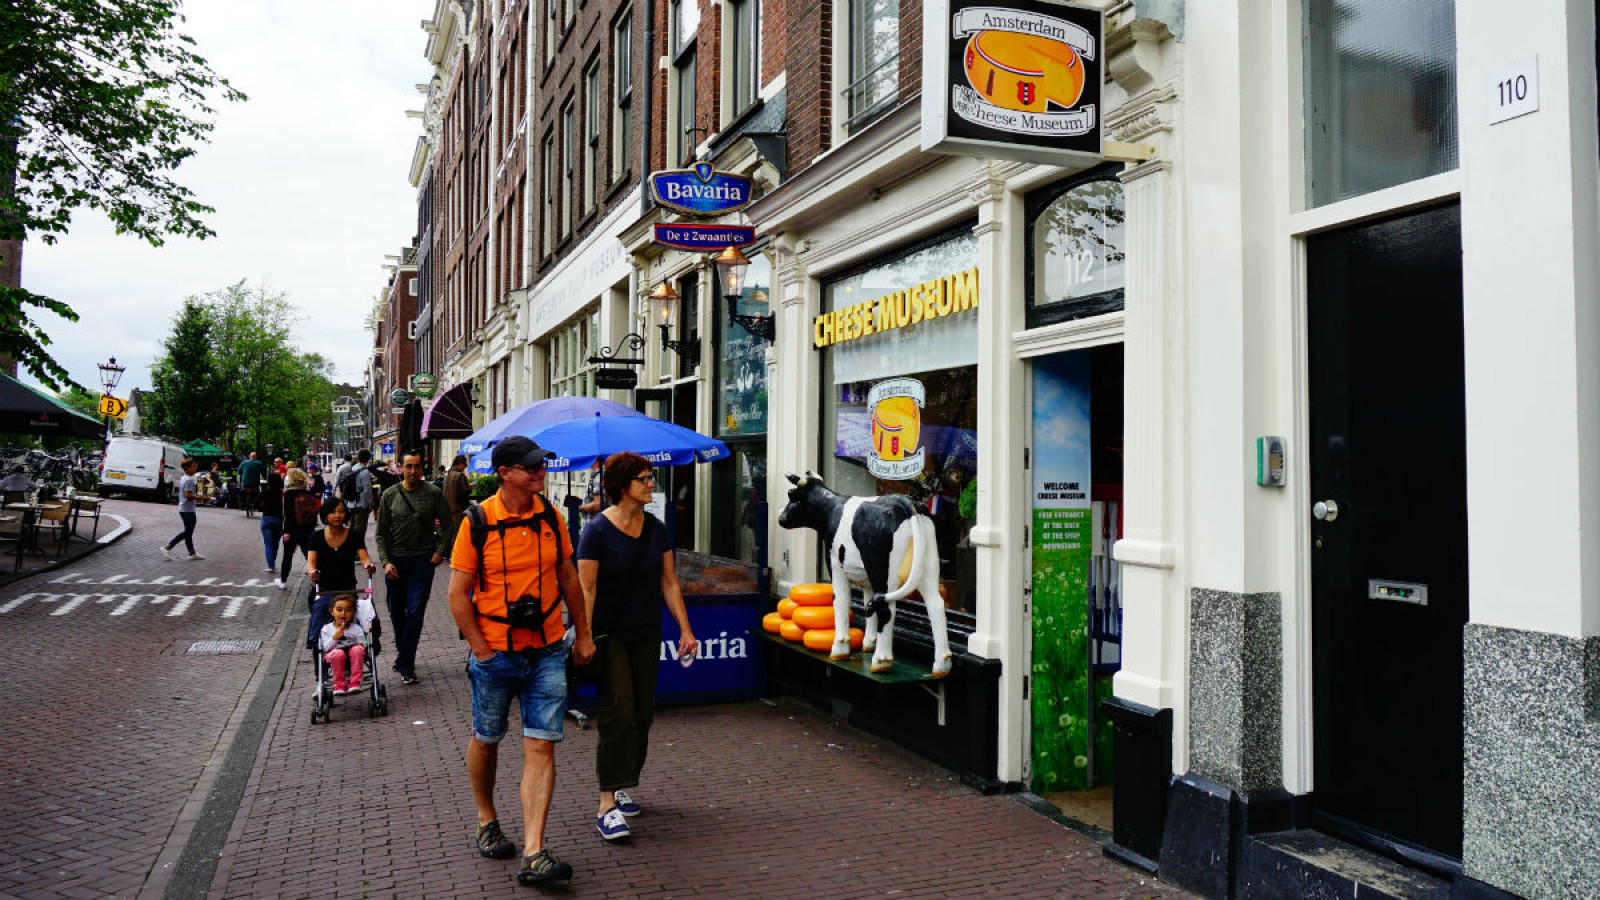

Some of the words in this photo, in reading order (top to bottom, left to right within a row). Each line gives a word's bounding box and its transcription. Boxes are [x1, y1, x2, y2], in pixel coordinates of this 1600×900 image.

[982, 13, 1065, 40] Amsterdam
[1498, 74, 1528, 107] 110
[1021, 114, 1084, 130] Museum
[666, 182, 742, 201] Bavaria
[666, 230, 681, 240] De
[683, 231, 690, 241] 2
[1067, 249, 1094, 286] 112
[814, 299, 876, 348] CHEESE
[876, 266, 980, 333] MUSEUM
[107, 400, 114, 413] B
[1043, 482, 1080, 490] WELCOME
[1064, 532, 1080, 540] SHOP
